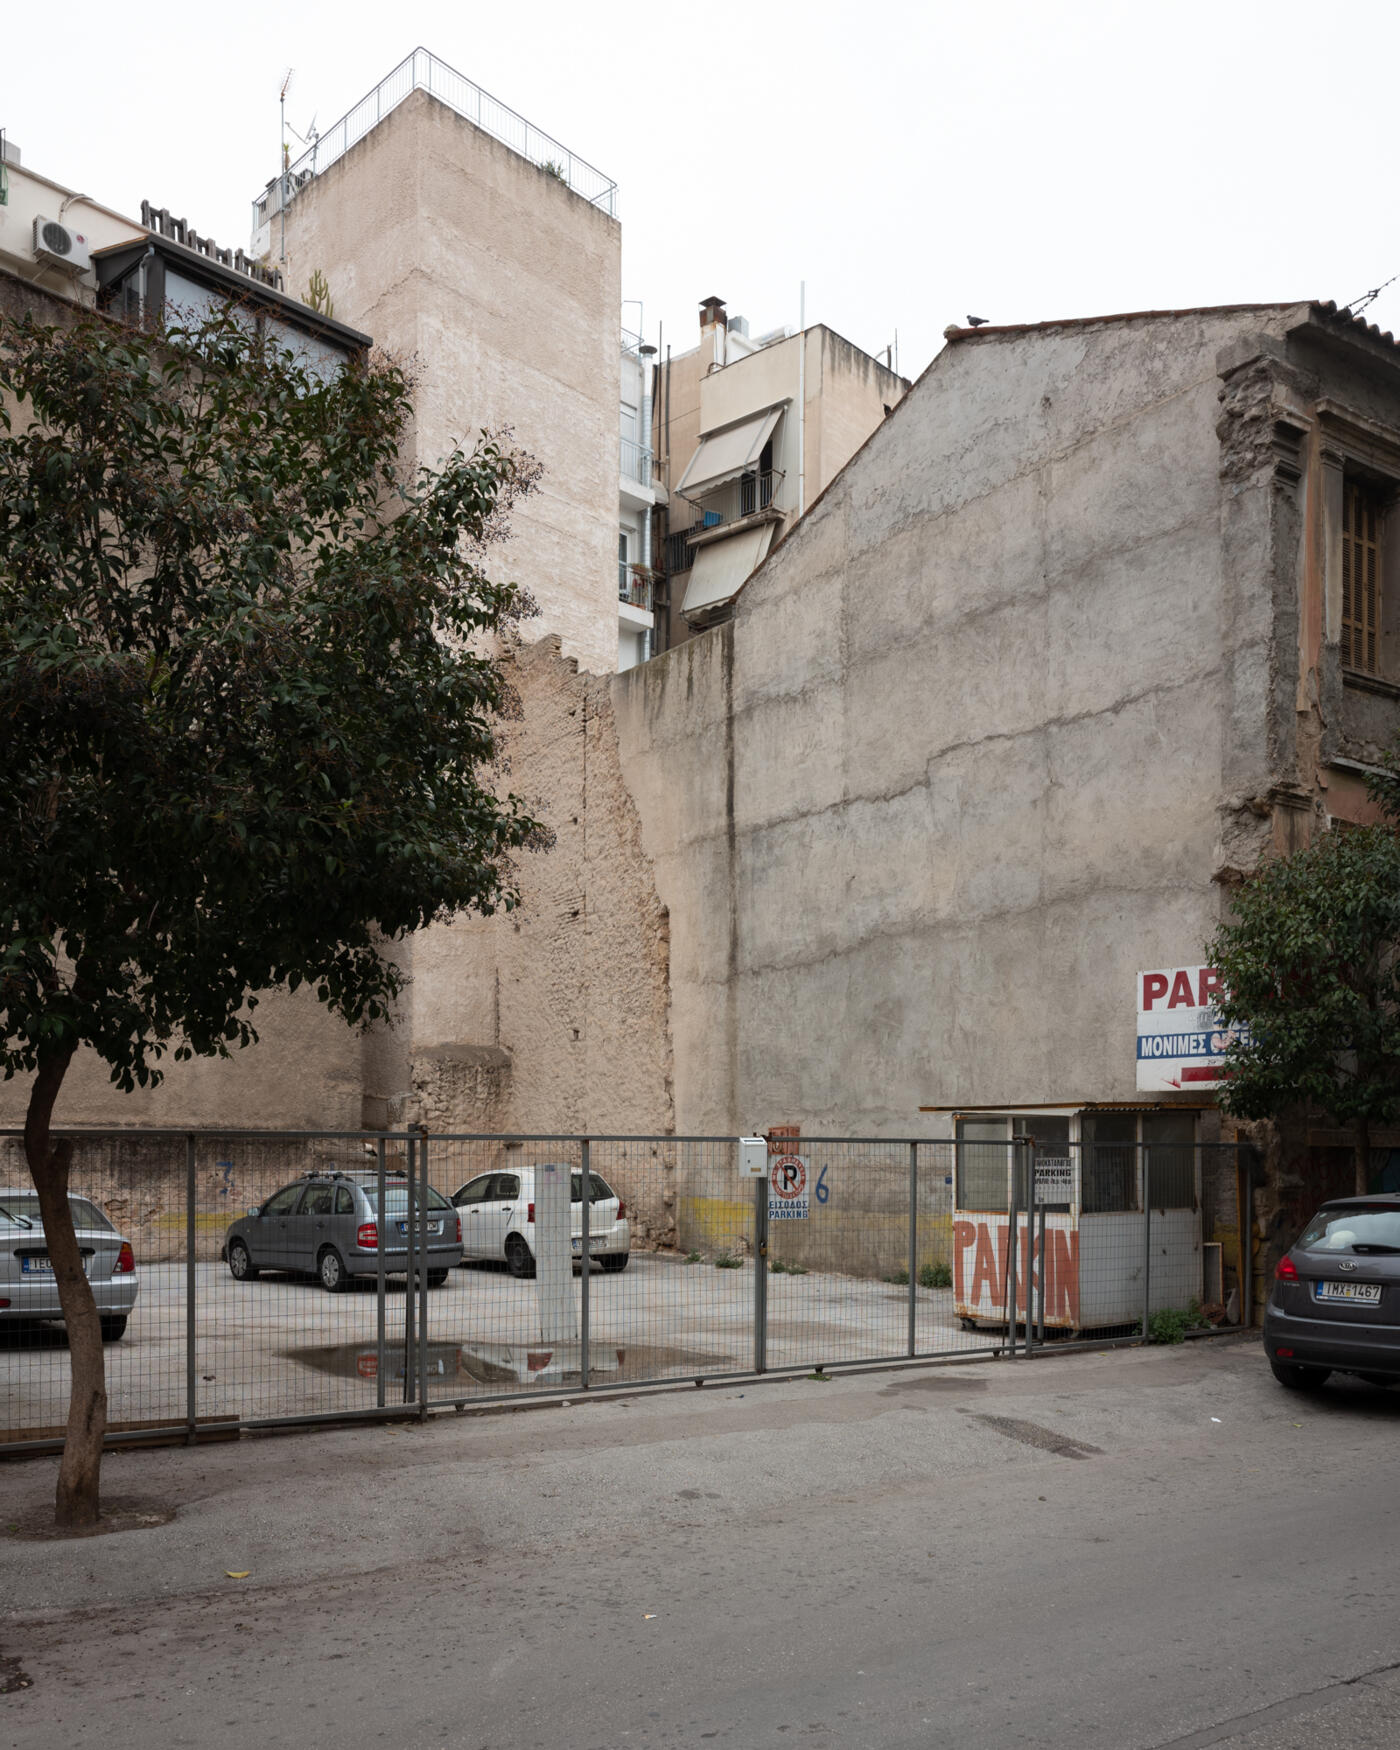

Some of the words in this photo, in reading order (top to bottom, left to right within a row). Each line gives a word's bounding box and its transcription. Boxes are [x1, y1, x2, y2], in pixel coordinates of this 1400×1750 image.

[1143, 967, 1238, 1011] PAR
[1141, 1034, 1206, 1056] ΜΟΝΙΜΕΣ
[816, 1163, 829, 1204] 6
[769, 1201, 808, 1209] ΕΙΣΟΔΟΣ
[769, 1210, 808, 1219] PARKING
